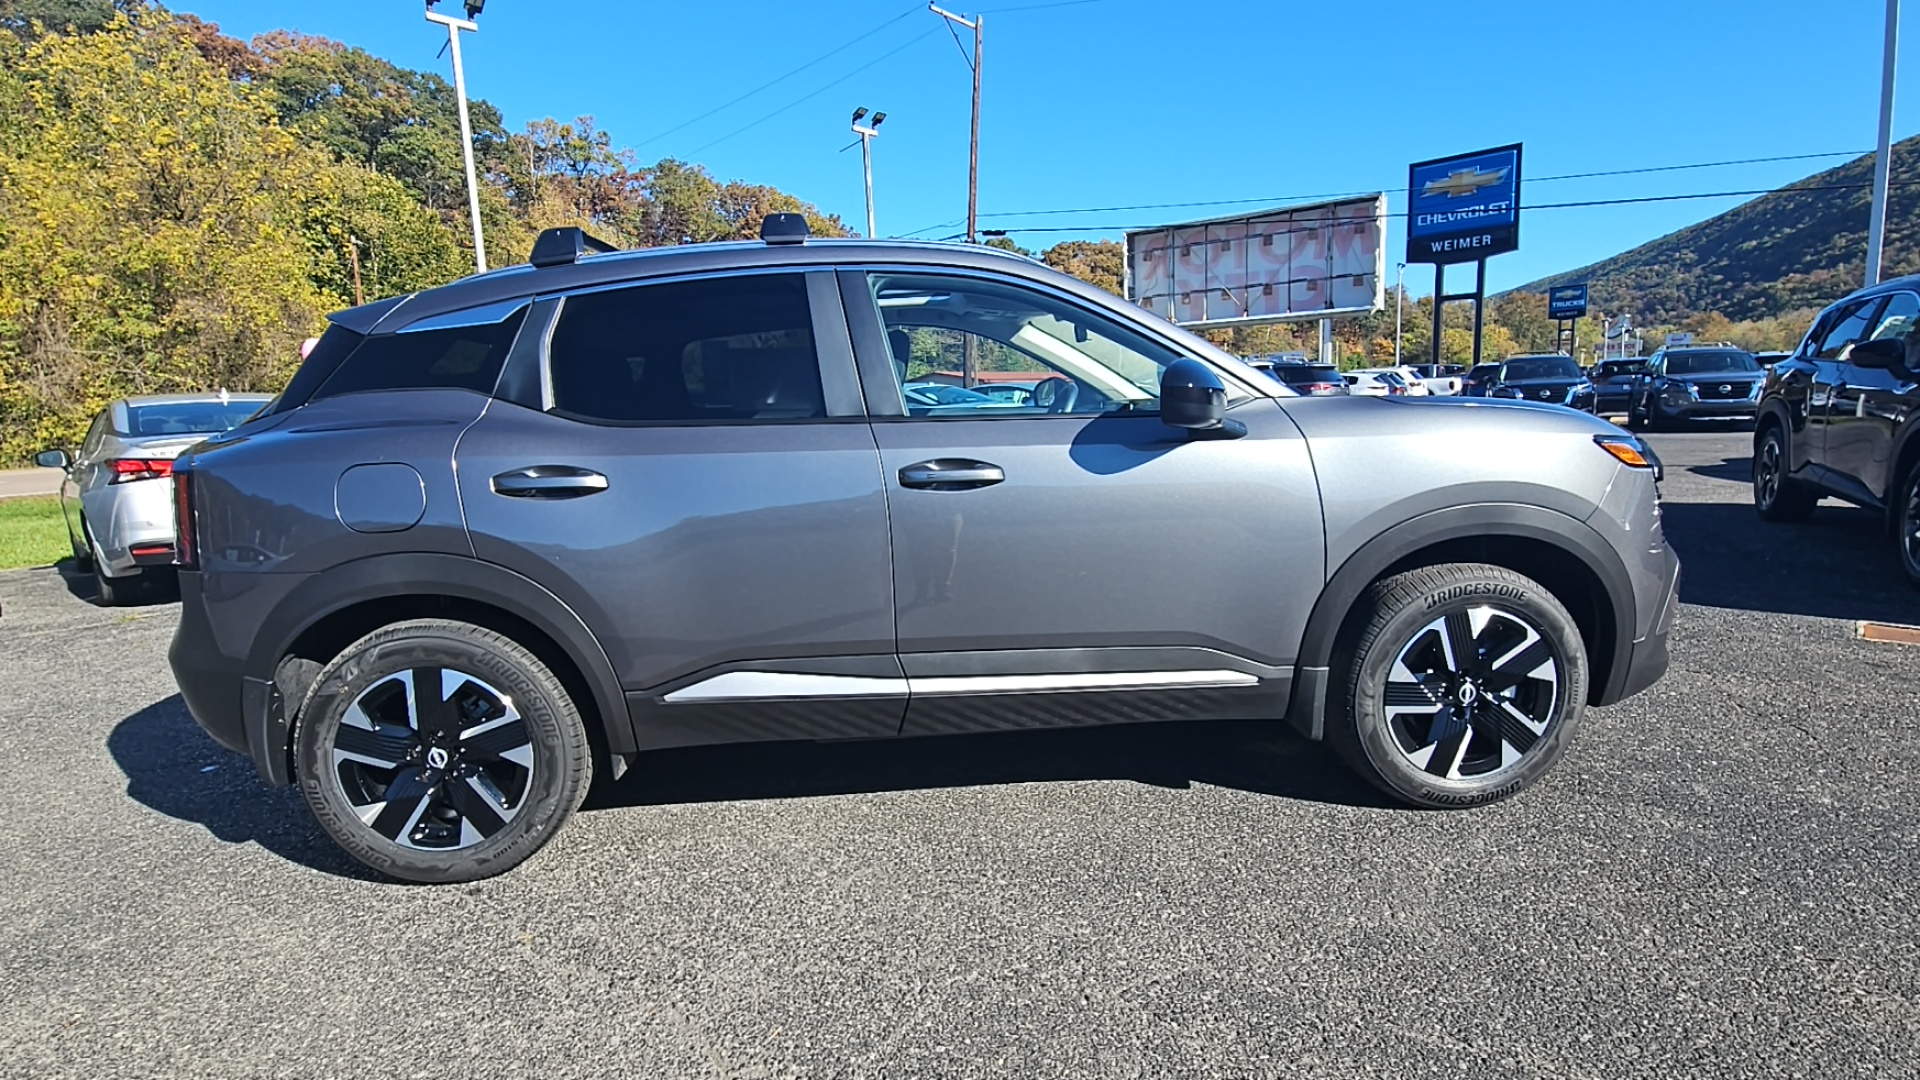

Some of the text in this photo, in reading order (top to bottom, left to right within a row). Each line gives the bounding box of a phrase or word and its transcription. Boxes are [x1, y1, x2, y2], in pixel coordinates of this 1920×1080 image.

[1417, 201, 1510, 226] CHEVROLET
[1430, 234, 1492, 252] WEIMER
[1552, 299, 1585, 308] TRUCKS
[1423, 582, 1529, 610] BRIDGESTONE
[474, 651, 560, 741] BRIDGESTONE
[1419, 780, 1522, 806] BRIDGESTONE
[306, 780, 393, 866] BRIDGESTONE
